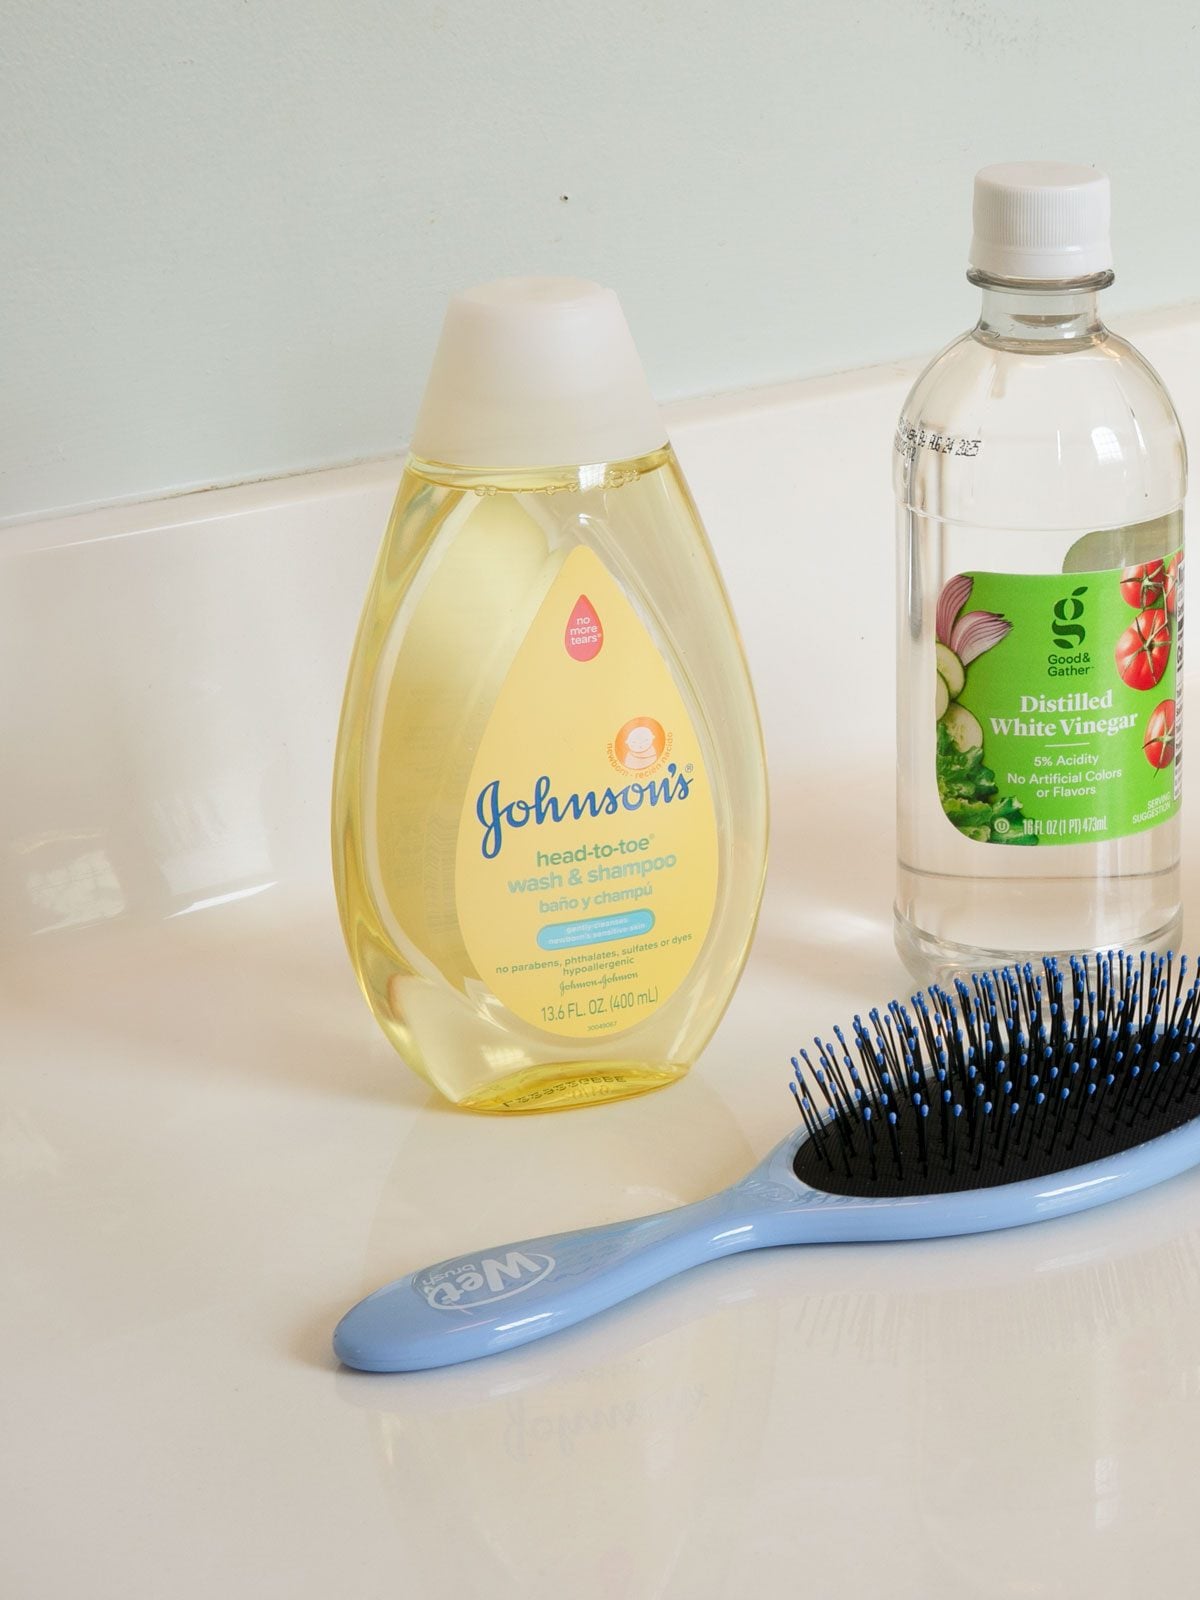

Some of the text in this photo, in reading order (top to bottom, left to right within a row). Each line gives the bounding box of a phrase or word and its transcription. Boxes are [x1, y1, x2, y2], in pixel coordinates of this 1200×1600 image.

[570, 625, 598, 635] more
[576, 616, 590, 626] no
[571, 634, 598, 646] tears
[1047, 665, 1091, 677] Gather
[1019, 688, 1113, 714] Distilled
[990, 712, 1138, 738] White Vinegar
[1033, 753, 1099, 767] 5% Acidity
[1007, 768, 1122, 785] No Artificial Colors
[1036, 785, 1097, 798] or Flavors
[476, 763, 694, 859] Johnson's
[1035, 819, 1044, 835] FL
[1046, 819, 1058, 835] OZ
[536, 837, 650, 868] head-to-toe
[507, 853, 677, 894] wash & shampoo
[539, 881, 653, 914] baño y champú
[495, 932, 693, 975] no parabens, phthalates, sulfates or dyes
[562, 956, 635, 977] hypoallergenic
[541, 985, 659, 1022] 13.6 FL. OZ. (400 mL)
[422, 1263, 477, 1286] brush
[441, 1251, 542, 1305] Wet
